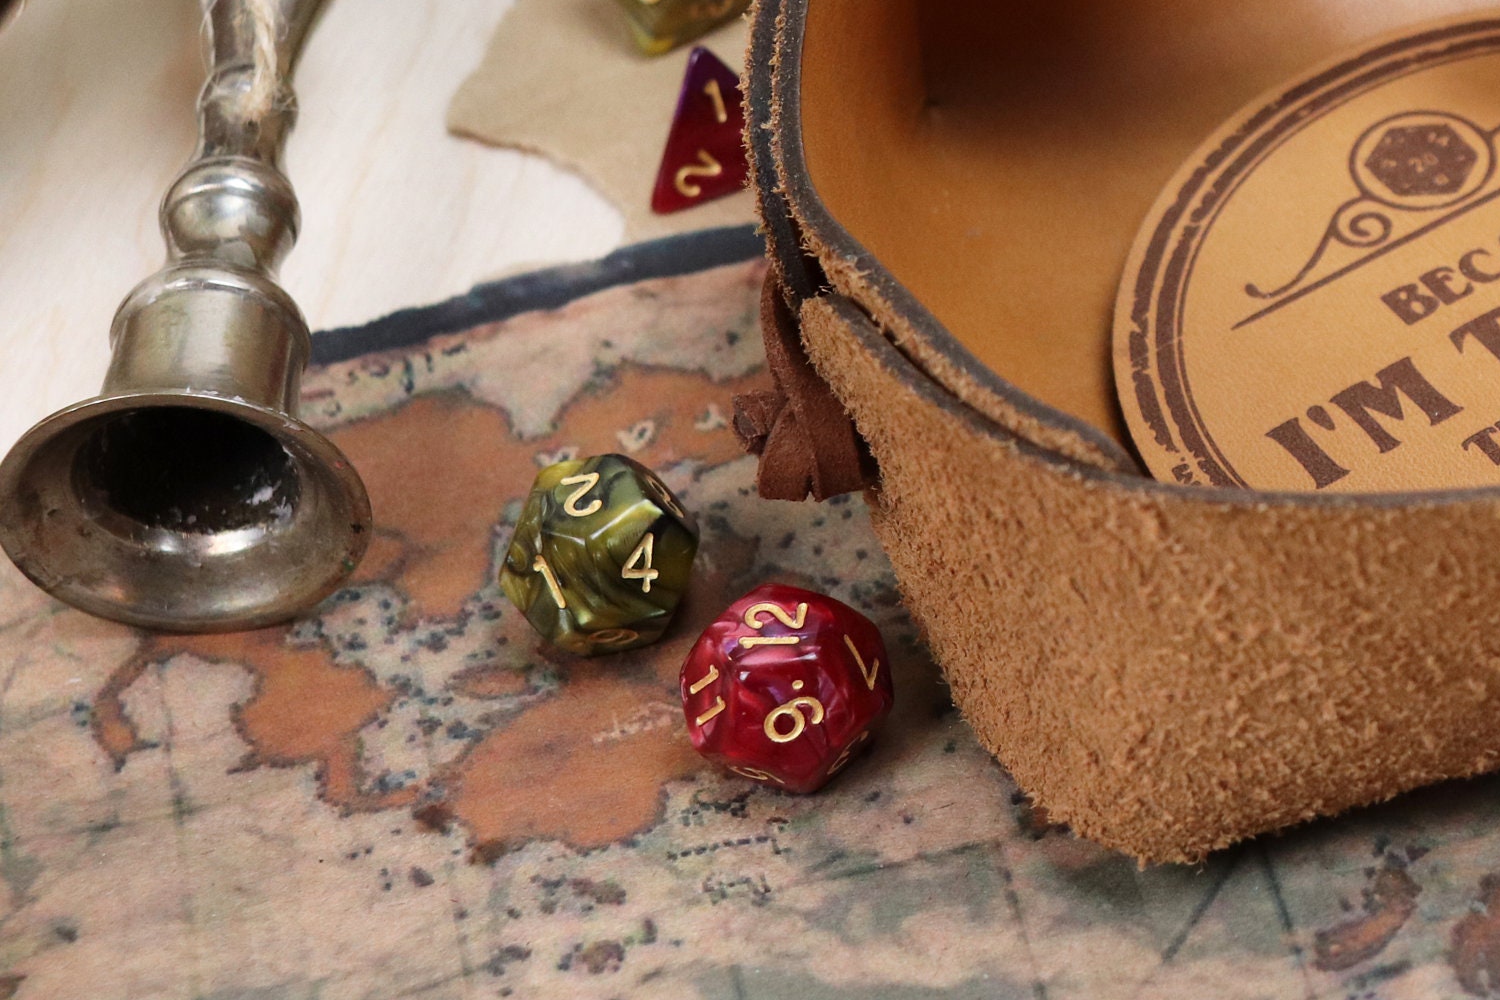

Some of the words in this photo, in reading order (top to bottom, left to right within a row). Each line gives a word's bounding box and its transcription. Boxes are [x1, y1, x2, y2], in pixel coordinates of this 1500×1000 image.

[704, 79, 728, 123] 1
[675, 149, 722, 197] 2
[1265, 356, 1464, 489] I'M
[560, 472, 603, 517] 2
[532, 554, 567, 609] 1
[621, 532, 660, 593] 4
[738, 602, 809, 649] 12
[844, 633, 880, 692] 7
[689, 663, 727, 727] 11
